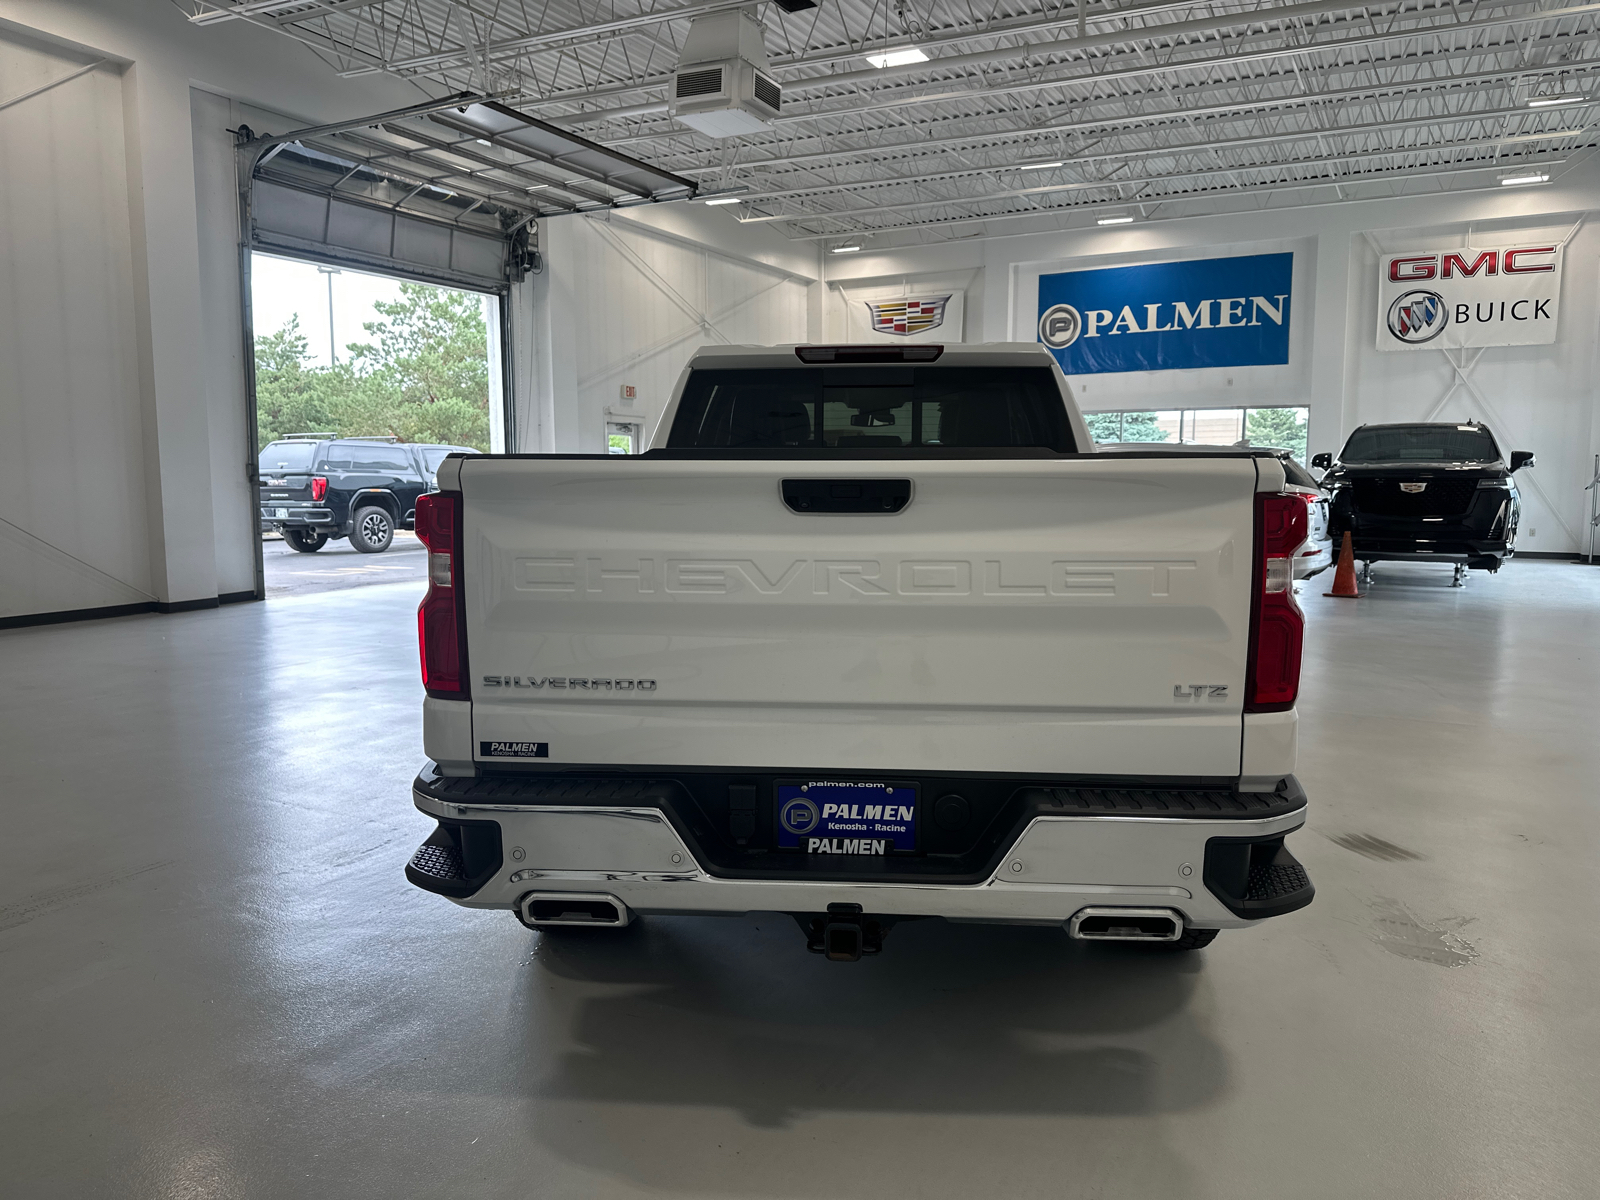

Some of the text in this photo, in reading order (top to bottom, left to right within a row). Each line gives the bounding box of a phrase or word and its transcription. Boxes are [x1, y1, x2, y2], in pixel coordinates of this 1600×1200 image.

[1388, 245, 1557, 283] GMC
[1083, 294, 1289, 338] PALMEN
[1455, 298, 1551, 324] BUICK
[513, 556, 1197, 596] CHEVROLET
[483, 675, 657, 691] SILVERADO
[1173, 684, 1229, 698] LTZ
[490, 742, 538, 752] PALMEN
[808, 781, 885, 789] palmen.com
[822, 803, 914, 821] PALMEN
[828, 822, 867, 831] Kenosha
[875, 823, 906, 832] Racine
[807, 838, 886, 855] PALMEN
